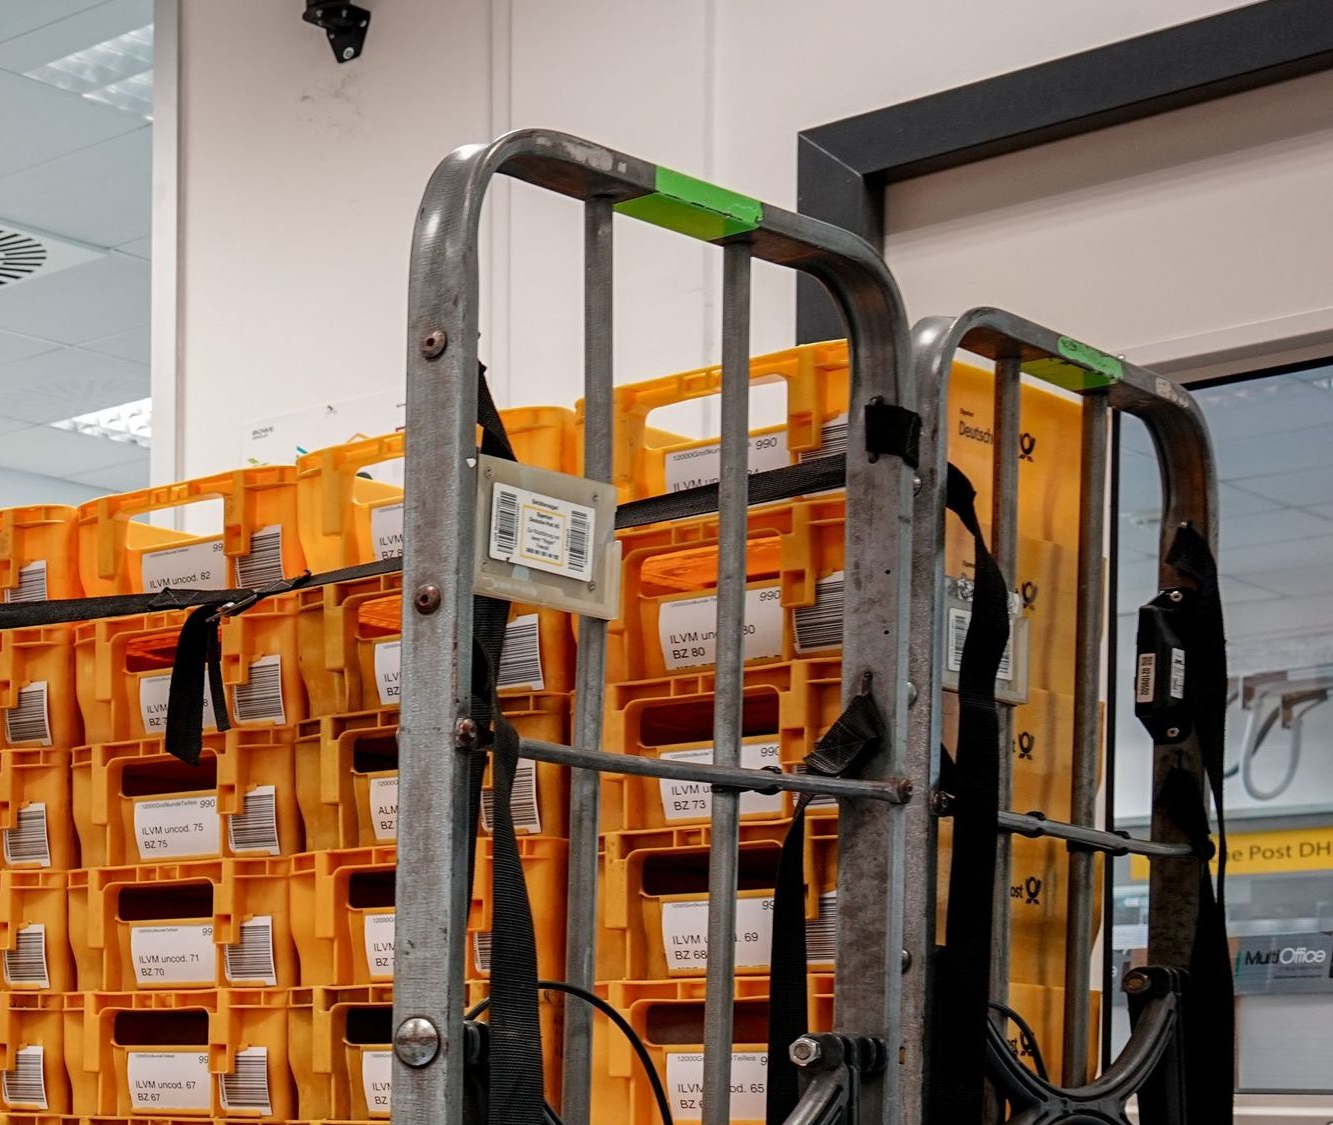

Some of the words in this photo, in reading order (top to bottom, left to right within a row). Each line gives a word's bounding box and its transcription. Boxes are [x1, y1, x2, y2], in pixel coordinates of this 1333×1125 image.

[959, 420, 994, 444] Deutsch
[755, 437, 777, 450] 990
[150, 578, 171, 589] ILVM
[200, 571, 211, 580] 82
[670, 632, 699, 644] ILVM
[672, 648, 689, 660] BZ
[691, 647, 706, 657] 80
[671, 784, 700, 796] ILVM
[199, 799, 215, 809] 990
[673, 800, 690, 811] BZ
[692, 799, 706, 809] 73
[142, 826, 163, 836] ILVM
[193, 823, 204, 832] 75
[144, 840, 156, 849] BZ
[157, 840, 168, 848] 75
[1249, 844, 1292, 861] Post
[1299, 841, 1333, 858] DH
[672, 934, 701, 945] ILVM
[744, 932, 759, 942] 69
[139, 955, 159, 964] ILVM
[190, 954, 199, 962] 71
[674, 950, 691, 960] BZ
[141, 968, 153, 977] BZ
[154, 968, 165, 976] 70
[135, 1080, 156, 1089] ILVM
[186, 1081, 196, 1089] 67
[750, 1083, 765, 1094] 65
[137, 1093, 149, 1101] BZ
[150, 1093, 160, 1102] 67
[680, 1099, 696, 1109] BZ
